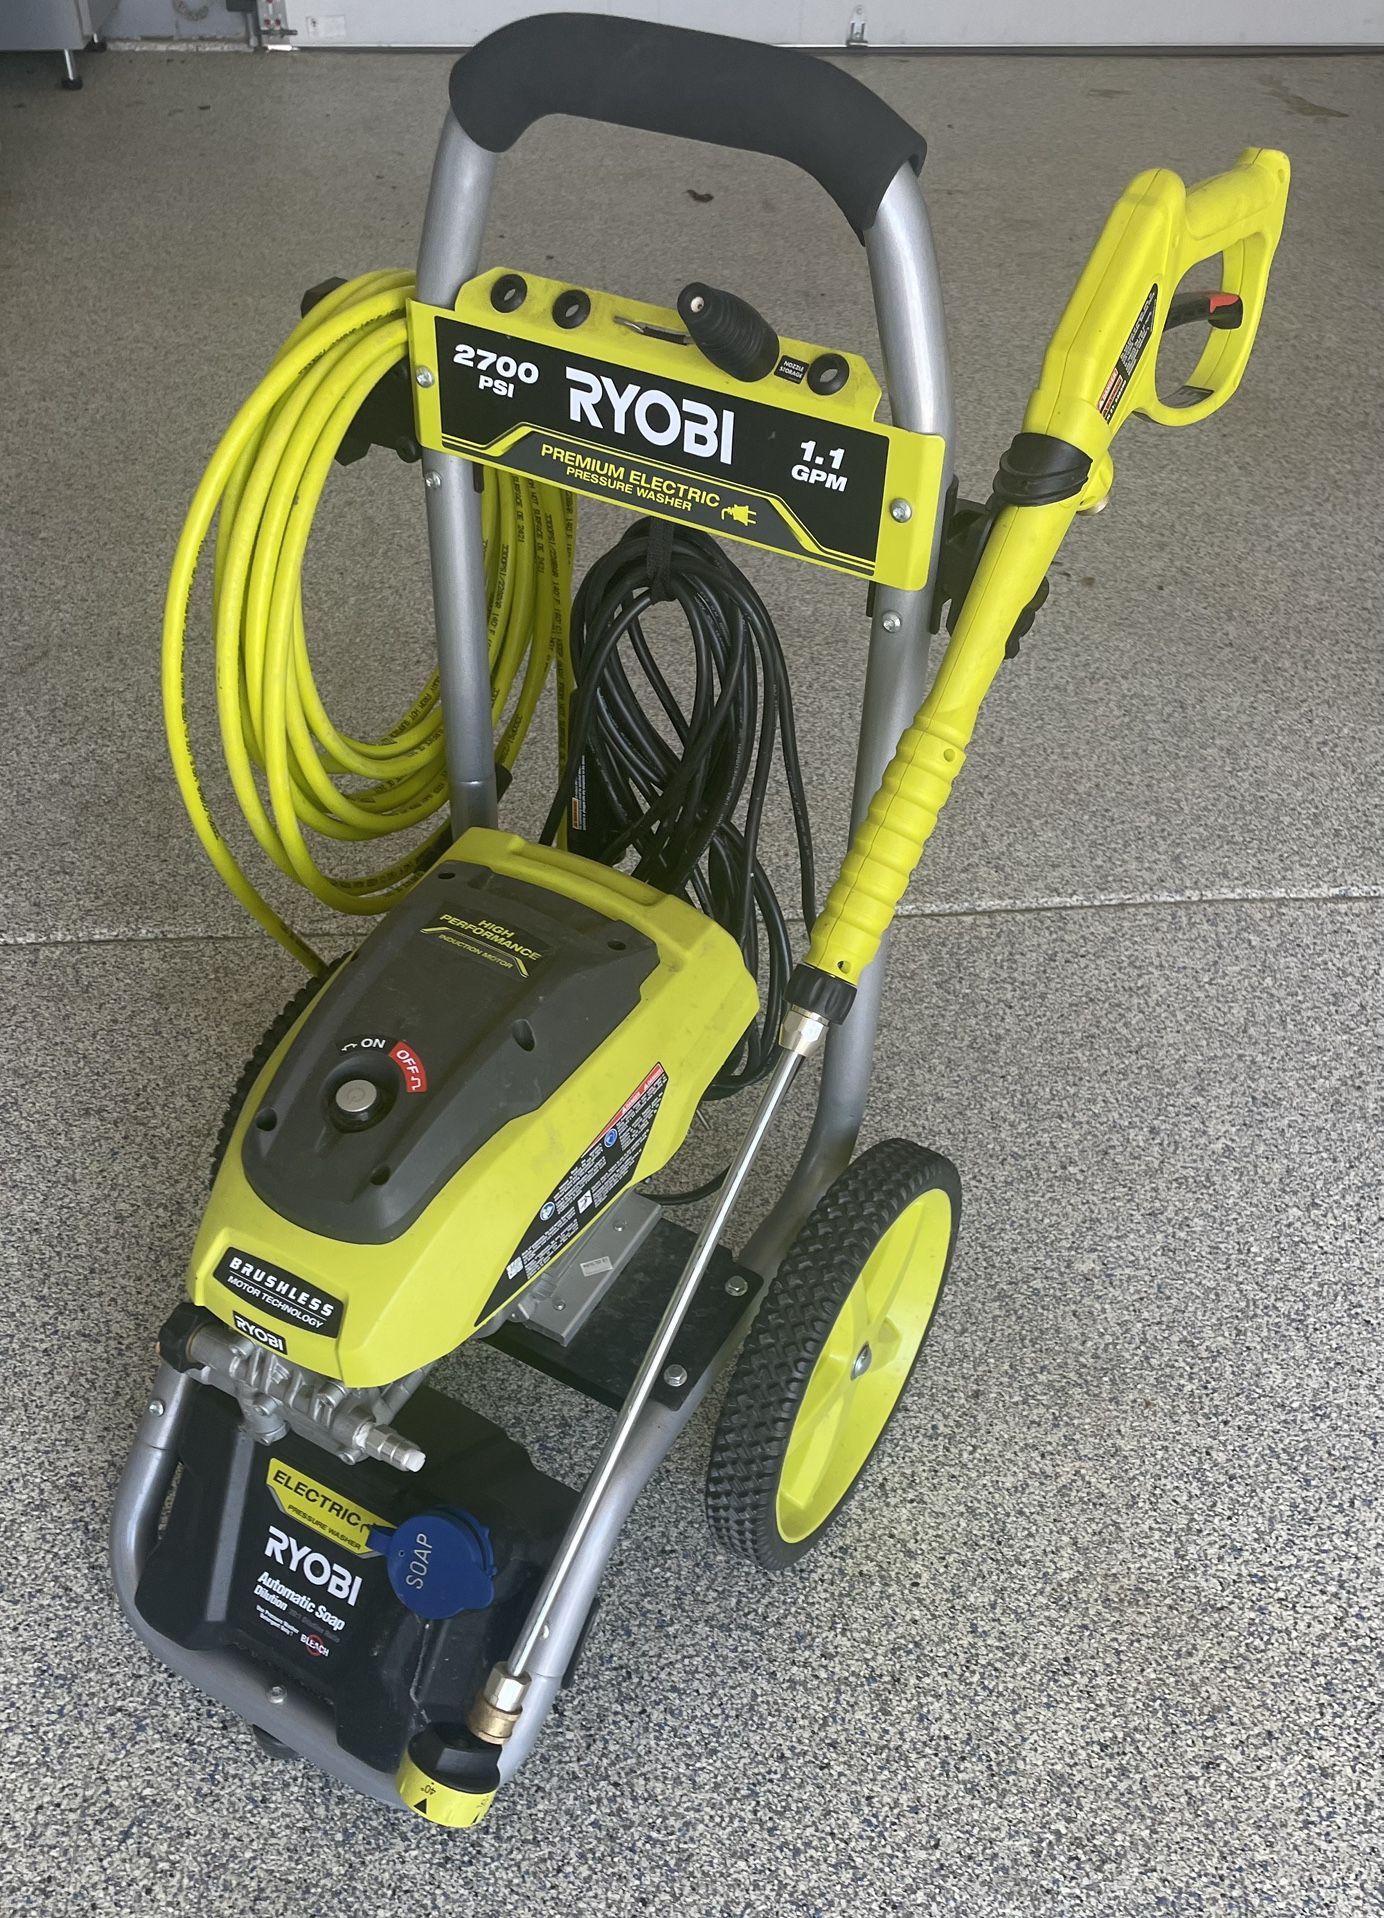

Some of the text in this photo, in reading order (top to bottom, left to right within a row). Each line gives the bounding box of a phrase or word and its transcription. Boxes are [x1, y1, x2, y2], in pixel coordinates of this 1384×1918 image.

[453, 344, 539, 384] 2700
[478, 375, 515, 398] PSI
[565, 366, 735, 465] RYOBI
[541, 443, 721, 508] PREMIUM ELECTRIC
[800, 440, 845, 470] 1.1
[566, 466, 692, 512] PRESSURE WASHER
[791, 464, 848, 492] GPM
[440, 914, 542, 960] PERFORMANCE
[478, 920, 515, 938] HIGH
[438, 934, 513, 969] INDUCTION MOTOR
[360, 1038, 386, 1049] ON
[396, 1050, 419, 1075] OFF
[227, 1275, 324, 1329] MOTOR TECHNOLOGY
[229, 1256, 334, 1317] BRUSHLESS
[235, 1315, 284, 1351] RYOBI
[273, 1469, 361, 1527] ELECTRIC
[288, 1504, 362, 1550] PRESSURE WASHER
[264, 1525, 363, 1607] RYOBI
[405, 1533, 433, 1590] SOAP
[253, 1584, 288, 1611] Dilution
[257, 1571, 316, 1613] Automatic
[315, 1604, 346, 1631] Soap
[300, 1633, 330, 1657] BLEACH
